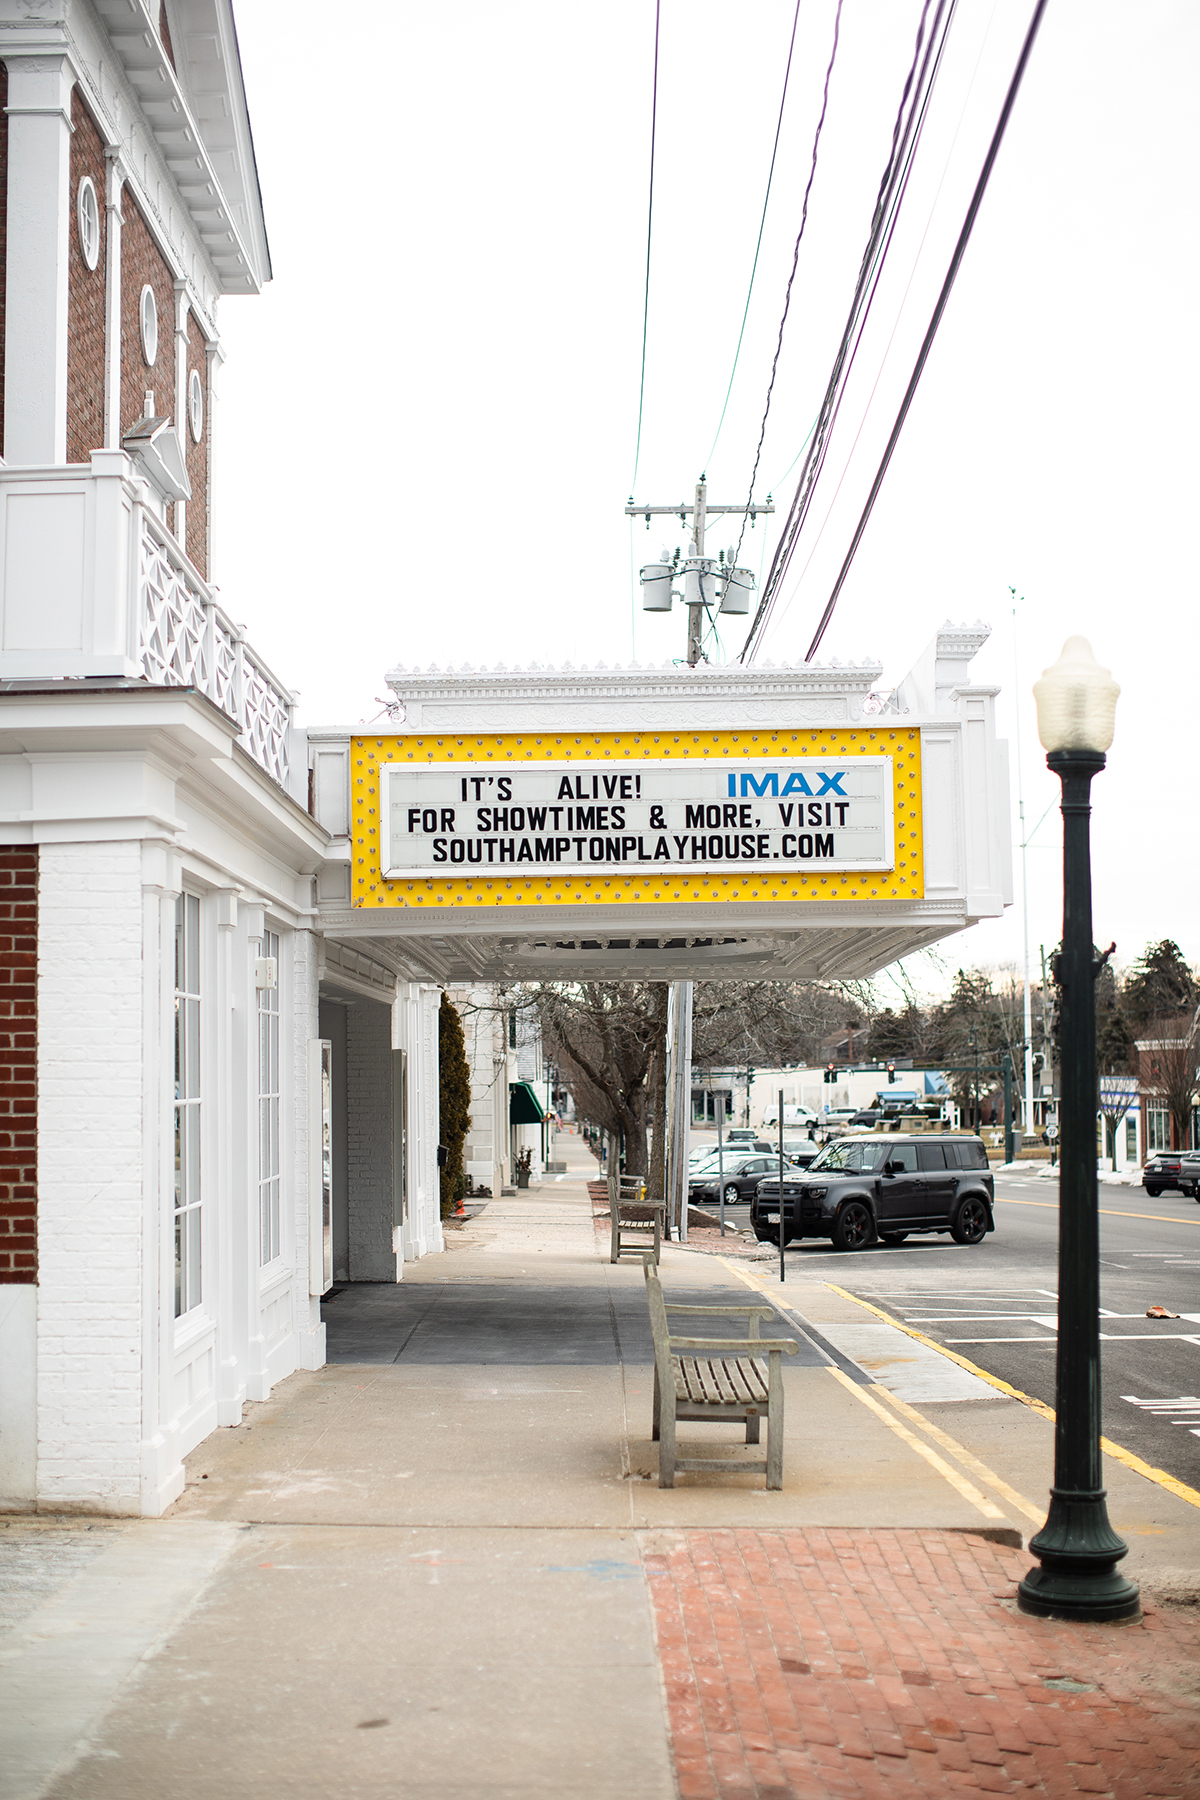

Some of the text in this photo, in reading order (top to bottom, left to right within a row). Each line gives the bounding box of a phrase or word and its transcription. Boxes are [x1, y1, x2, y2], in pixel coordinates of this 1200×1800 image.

[461, 774, 642, 802] IT'S ALIVE!
[728, 772, 848, 797] IMAX
[408, 802, 850, 833] FOR SHOWTIMES & MORE, VISIT
[433, 833, 834, 863] SOUTHAMPTONPLAYHOUSE.COM
